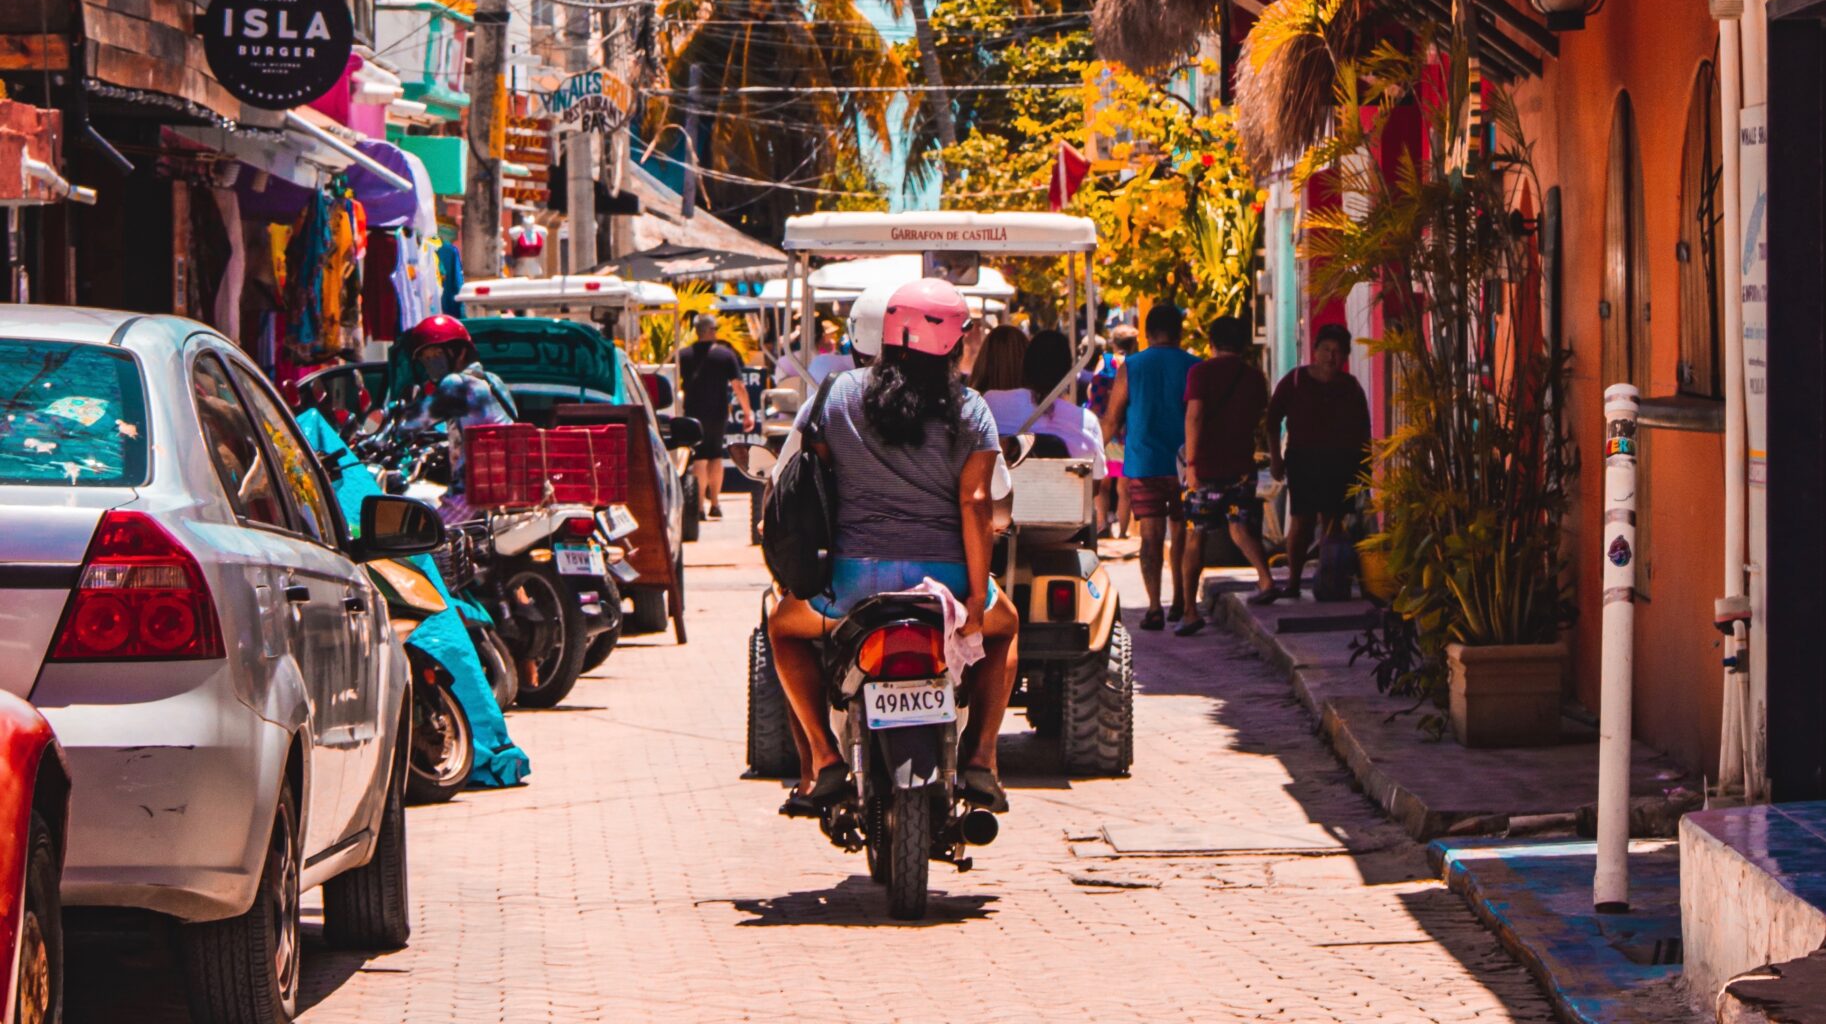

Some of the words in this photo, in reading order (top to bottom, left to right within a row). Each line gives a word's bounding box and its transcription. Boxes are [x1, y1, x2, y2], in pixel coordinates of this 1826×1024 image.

[224, 8, 332, 40] ISLA
[238, 45, 316, 58] BURGER
[240, 83, 312, 101] HANDMADE
[582, 112, 606, 133] BAR
[890, 227, 943, 241] GARRAFON
[946, 231, 959, 241] DE
[962, 227, 1007, 241] CASTILLA
[875, 690, 945, 714] 49AXC9
